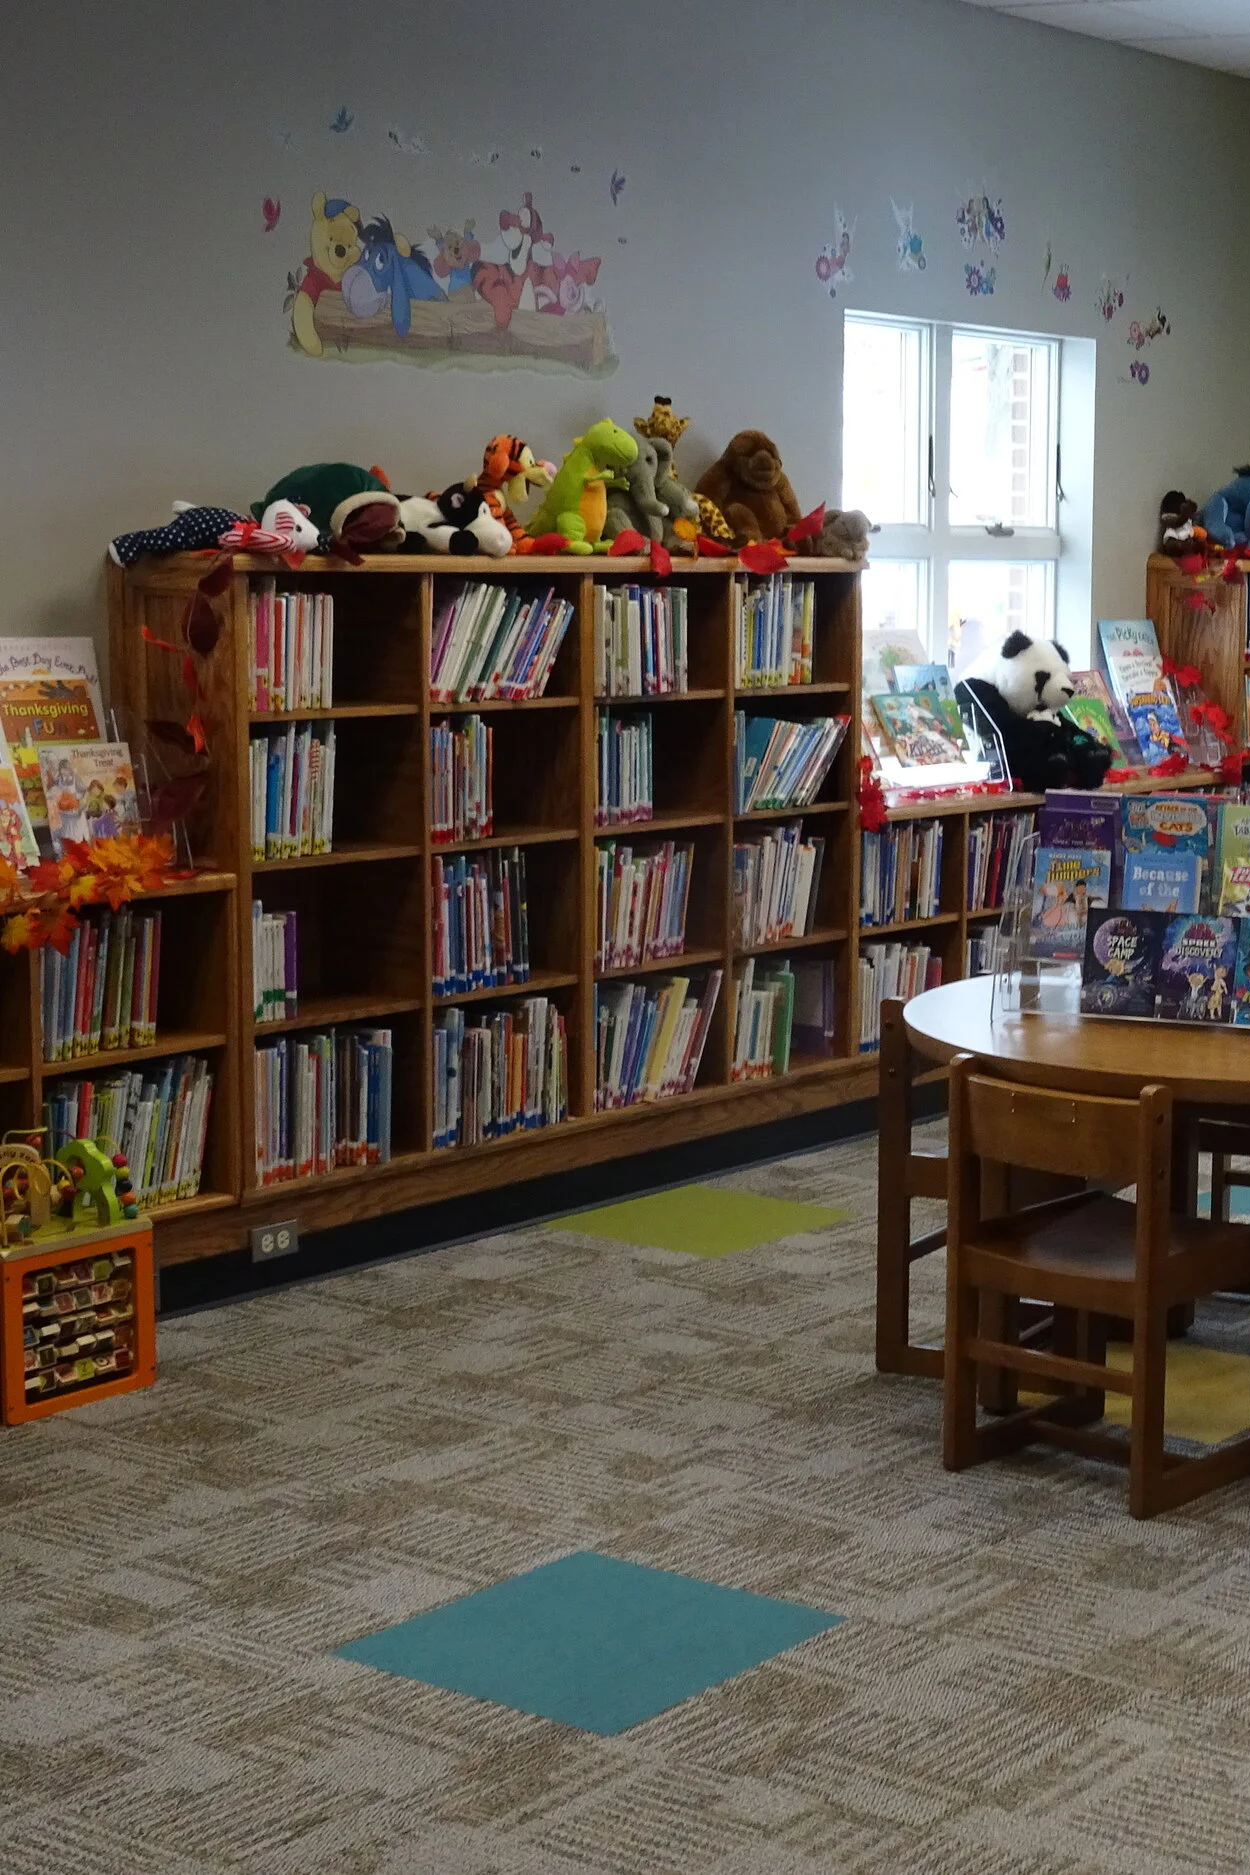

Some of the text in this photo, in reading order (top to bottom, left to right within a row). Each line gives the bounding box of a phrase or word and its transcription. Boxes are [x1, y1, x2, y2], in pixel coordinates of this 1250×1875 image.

[33, 652, 53, 669] Day
[4, 701, 89, 718] Thanksgiving
[1159, 822, 1193, 832] CATS
[1133, 866, 1189, 882] Because
[1139, 882, 1180, 898] of the
[1107, 935, 1139, 948] SPACE
[1107, 948, 1135, 960] CAMP
